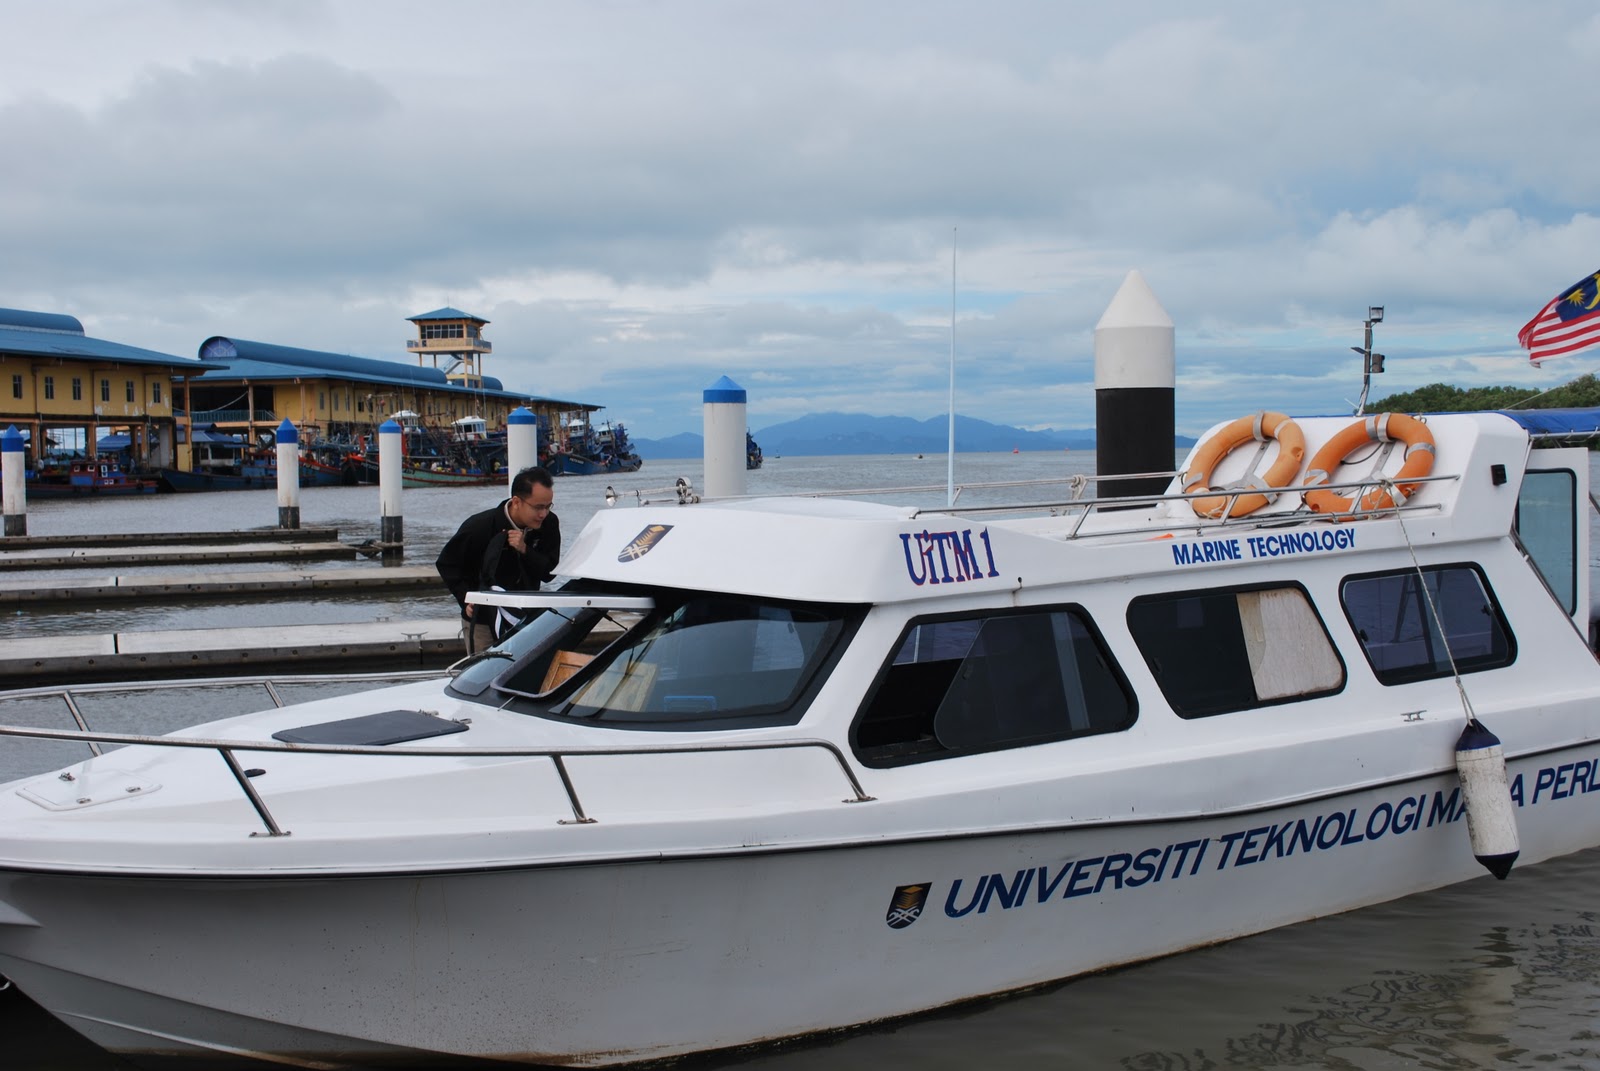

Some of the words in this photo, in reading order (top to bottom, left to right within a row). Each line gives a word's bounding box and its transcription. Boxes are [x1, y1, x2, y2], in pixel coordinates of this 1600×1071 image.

[1172, 539, 1242, 565] MARINE
[1247, 528, 1355, 558] TECHNOLOGY
[944, 838, 1210, 918] UNIVERSITI
[1216, 794, 1427, 871] TEKNOLOGI
